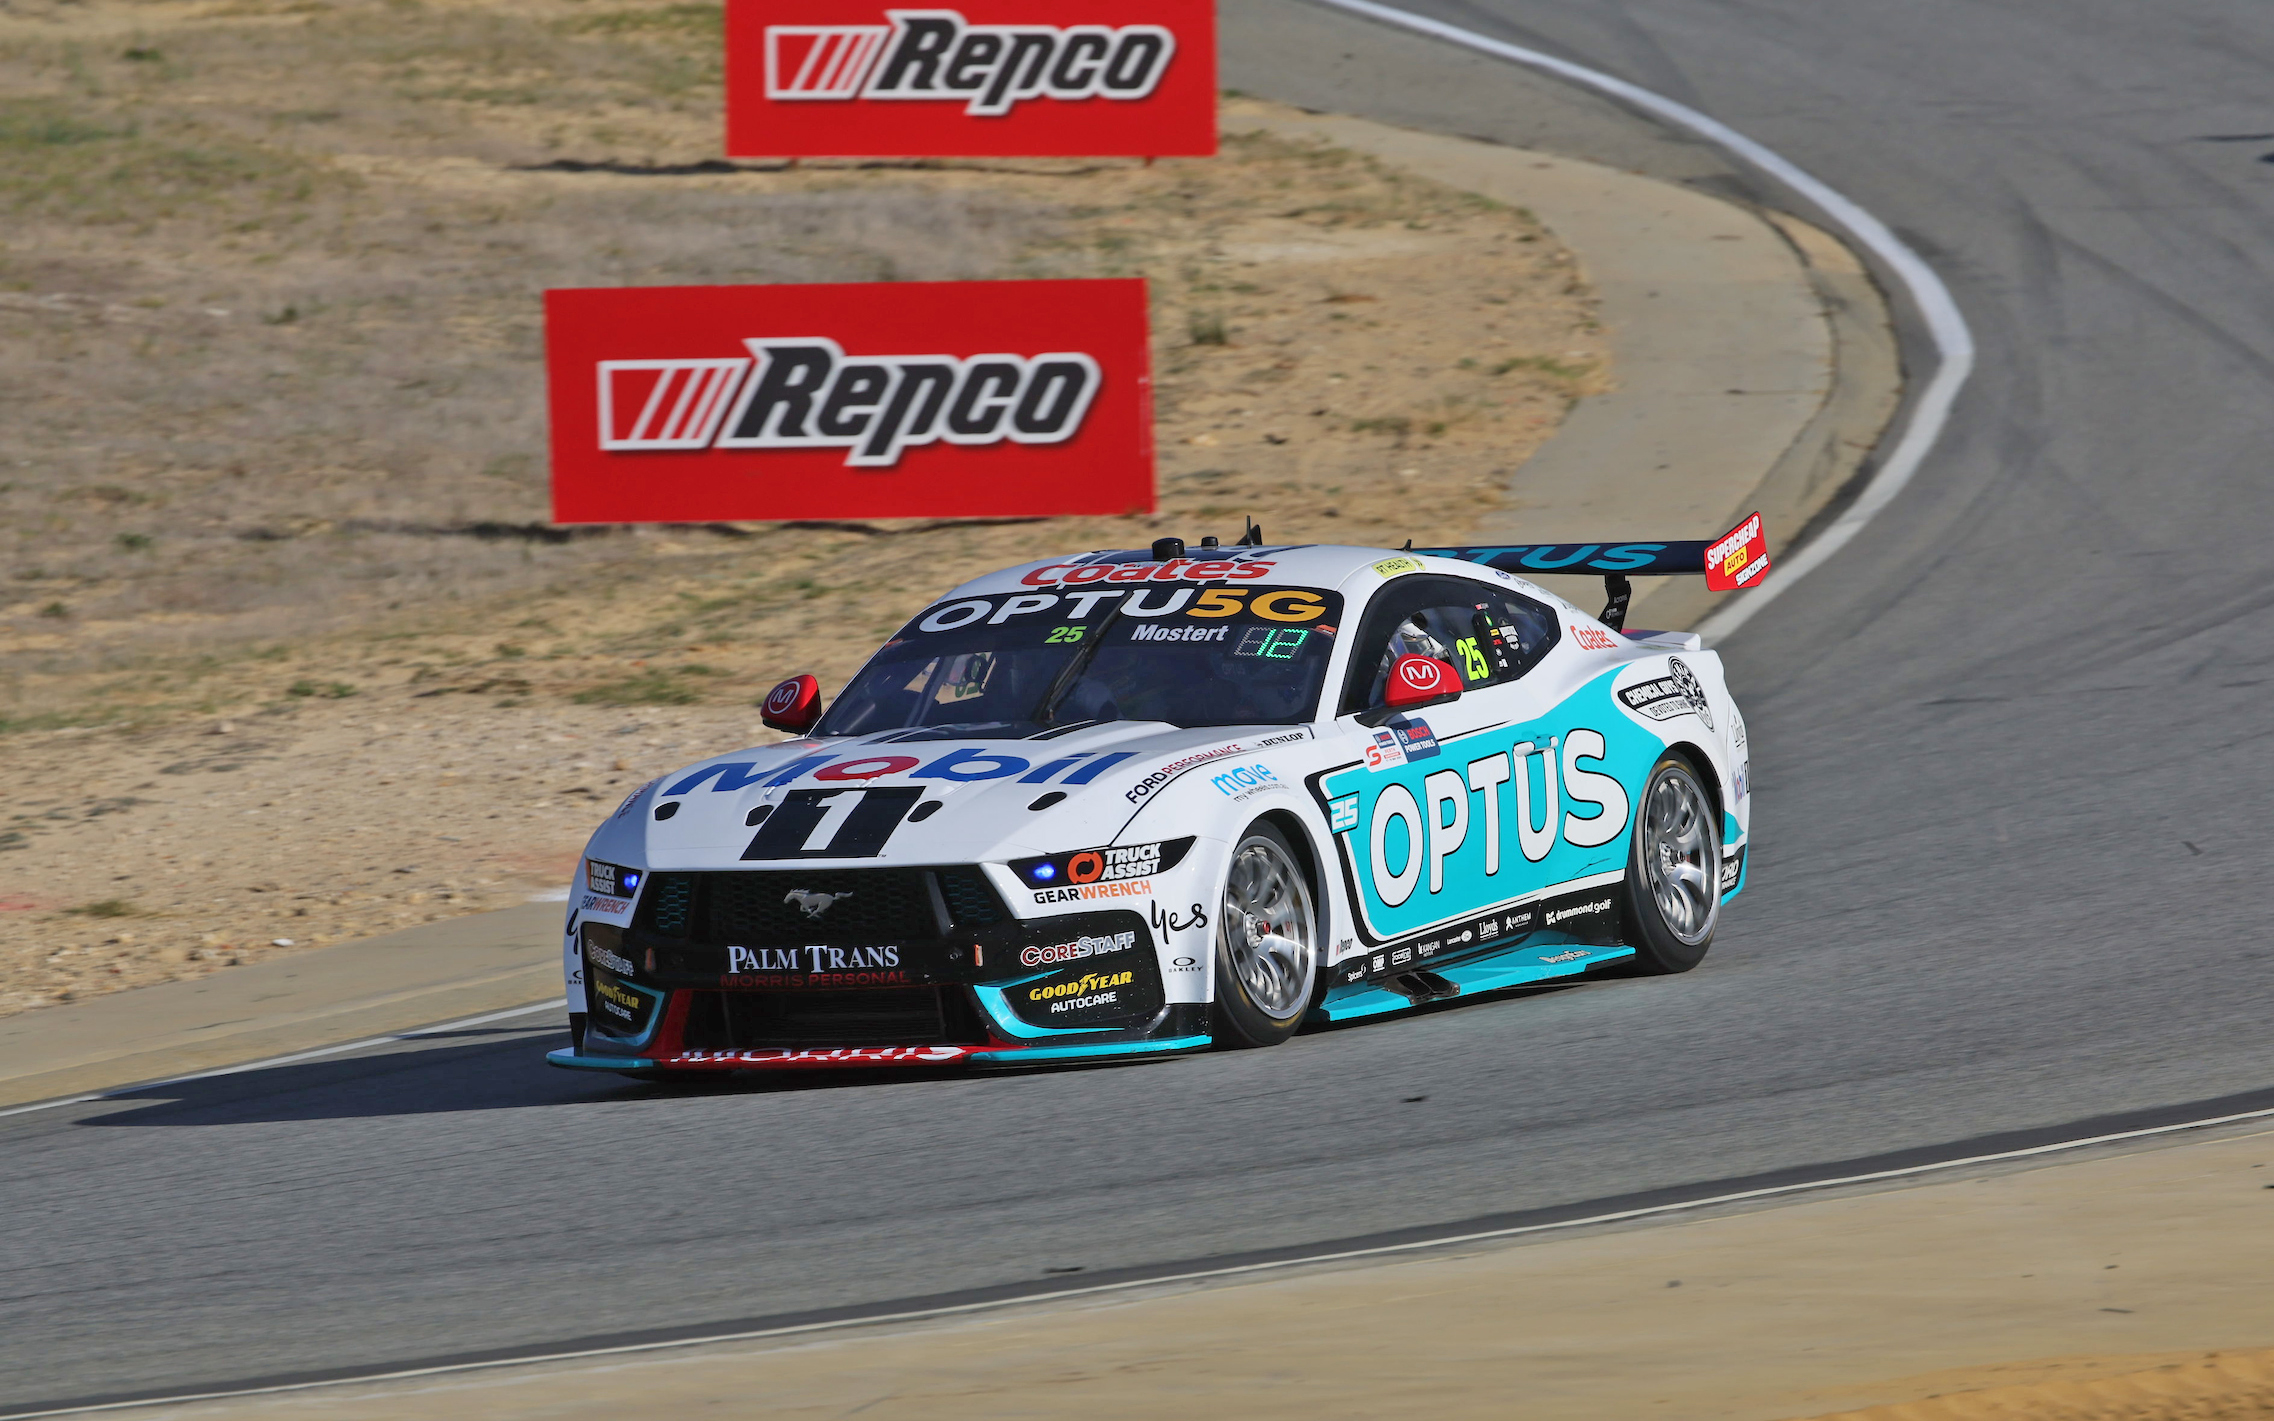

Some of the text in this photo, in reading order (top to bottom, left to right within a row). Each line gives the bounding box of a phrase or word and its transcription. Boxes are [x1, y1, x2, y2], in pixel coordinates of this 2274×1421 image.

[866, 12, 1170, 111] Repco
[720, 340, 1096, 462] Repco
[1707, 515, 1759, 570] SUPERCHEAP
[1020, 558, 1278, 586] Coates
[1727, 552, 1744, 571] AUTO
[1044, 625, 1088, 644] 25
[1130, 624, 1229, 643] Mostert
[1257, 628, 1309, 659] 12
[1570, 625, 1618, 650] Coates
[1456, 637, 1489, 681] 25
[1625, 683, 1662, 706] CHEMICAL
[1262, 732, 1304, 746] DUNLOP
[1407, 726, 1431, 740] BOSCH
[1404, 741, 1422, 753] POWER
[1421, 739, 1436, 749] TOOLS
[661, 748, 1142, 797] Mobil
[1125, 743, 1246, 804] FORD PERFORMANCE
[1210, 763, 1278, 796] move
[800, 790, 870, 851] 1
[1331, 796, 1358, 830] 25
[1370, 728, 1630, 907] OPTUS
[1104, 842, 1161, 863] TRUCK
[590, 861, 615, 880] TRUCK
[1100, 857, 1160, 881] ASSIST
[590, 879, 615, 895] ASSIST
[1034, 880, 1152, 904] GEARWRENCH
[1151, 899, 1209, 945] yes
[1478, 919, 1499, 936] Lloyds
[1512, 912, 1532, 924] ANTHEM
[727, 944, 900, 974] PALM TRANS
[1168, 965, 1203, 974] OAKLEY
[719, 970, 911, 988] MORRIS PERSONAL
[1029, 970, 1134, 1002] GOODYEAR
[1347, 970, 1364, 983] Spicers
[596, 980, 640, 1009] GOODYEAR
[1051, 991, 1117, 1014] AUTOCARE
[604, 1000, 633, 1022] AUTOCARE
